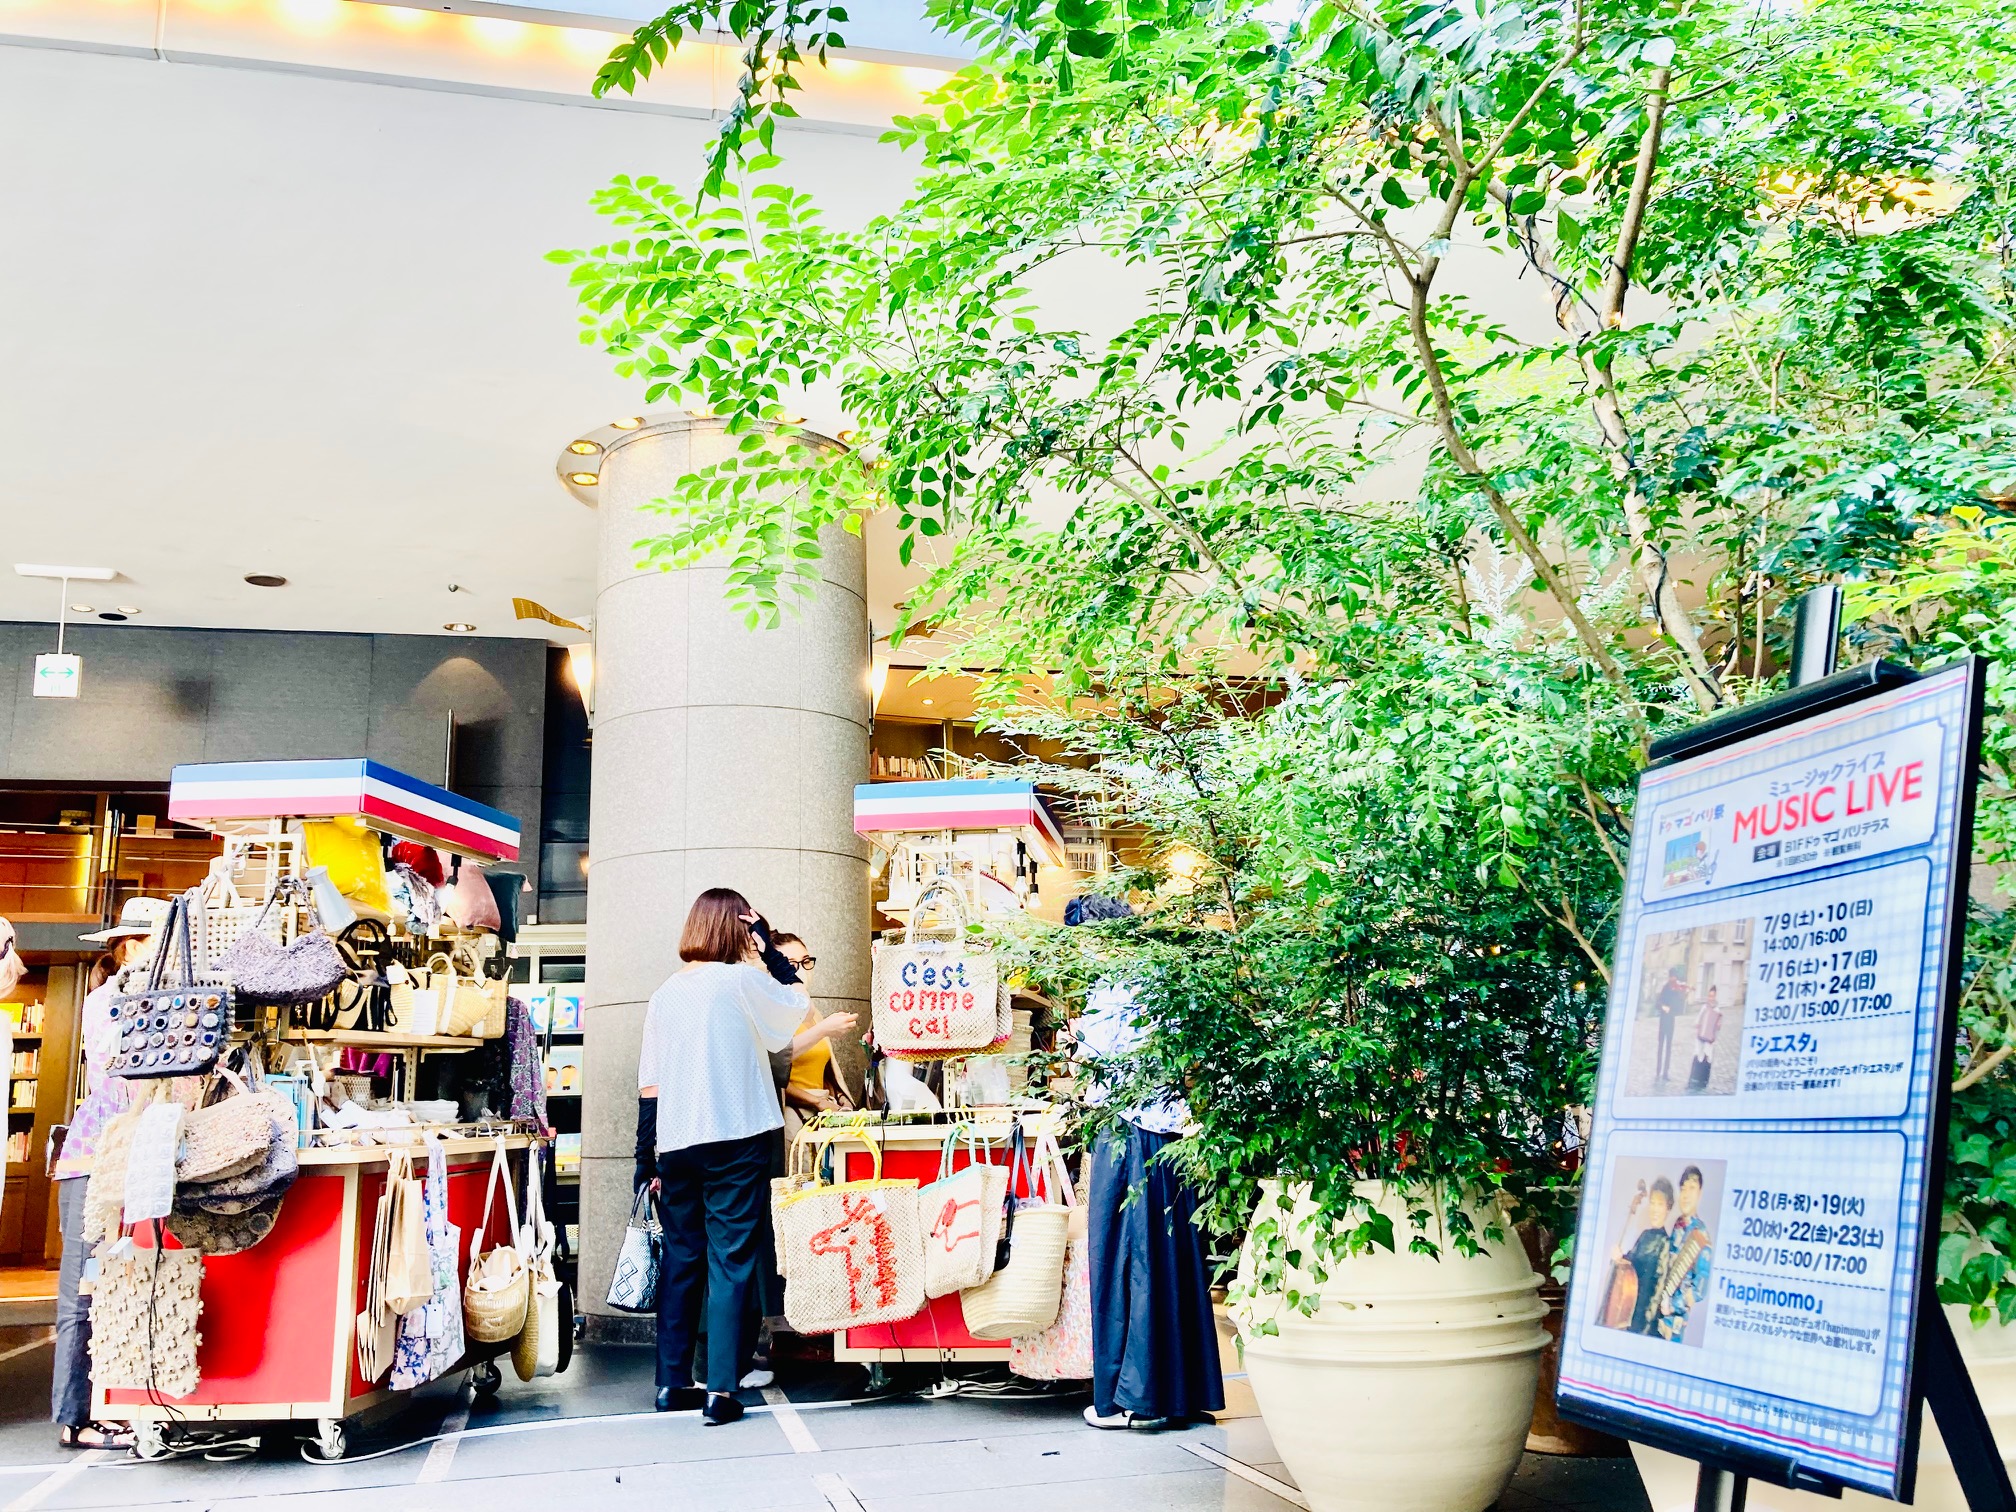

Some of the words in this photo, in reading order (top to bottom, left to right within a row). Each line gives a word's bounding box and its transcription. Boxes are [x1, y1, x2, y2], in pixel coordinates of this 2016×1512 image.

[1732, 785, 1836, 843] MUSIC
[1846, 760, 1924, 816] LIVE
[889, 990, 975, 1012] comme
[1750, 1032, 1818, 1055] 「シエスタ」
[1719, 1276, 1824, 1315] 「hapimomo」
